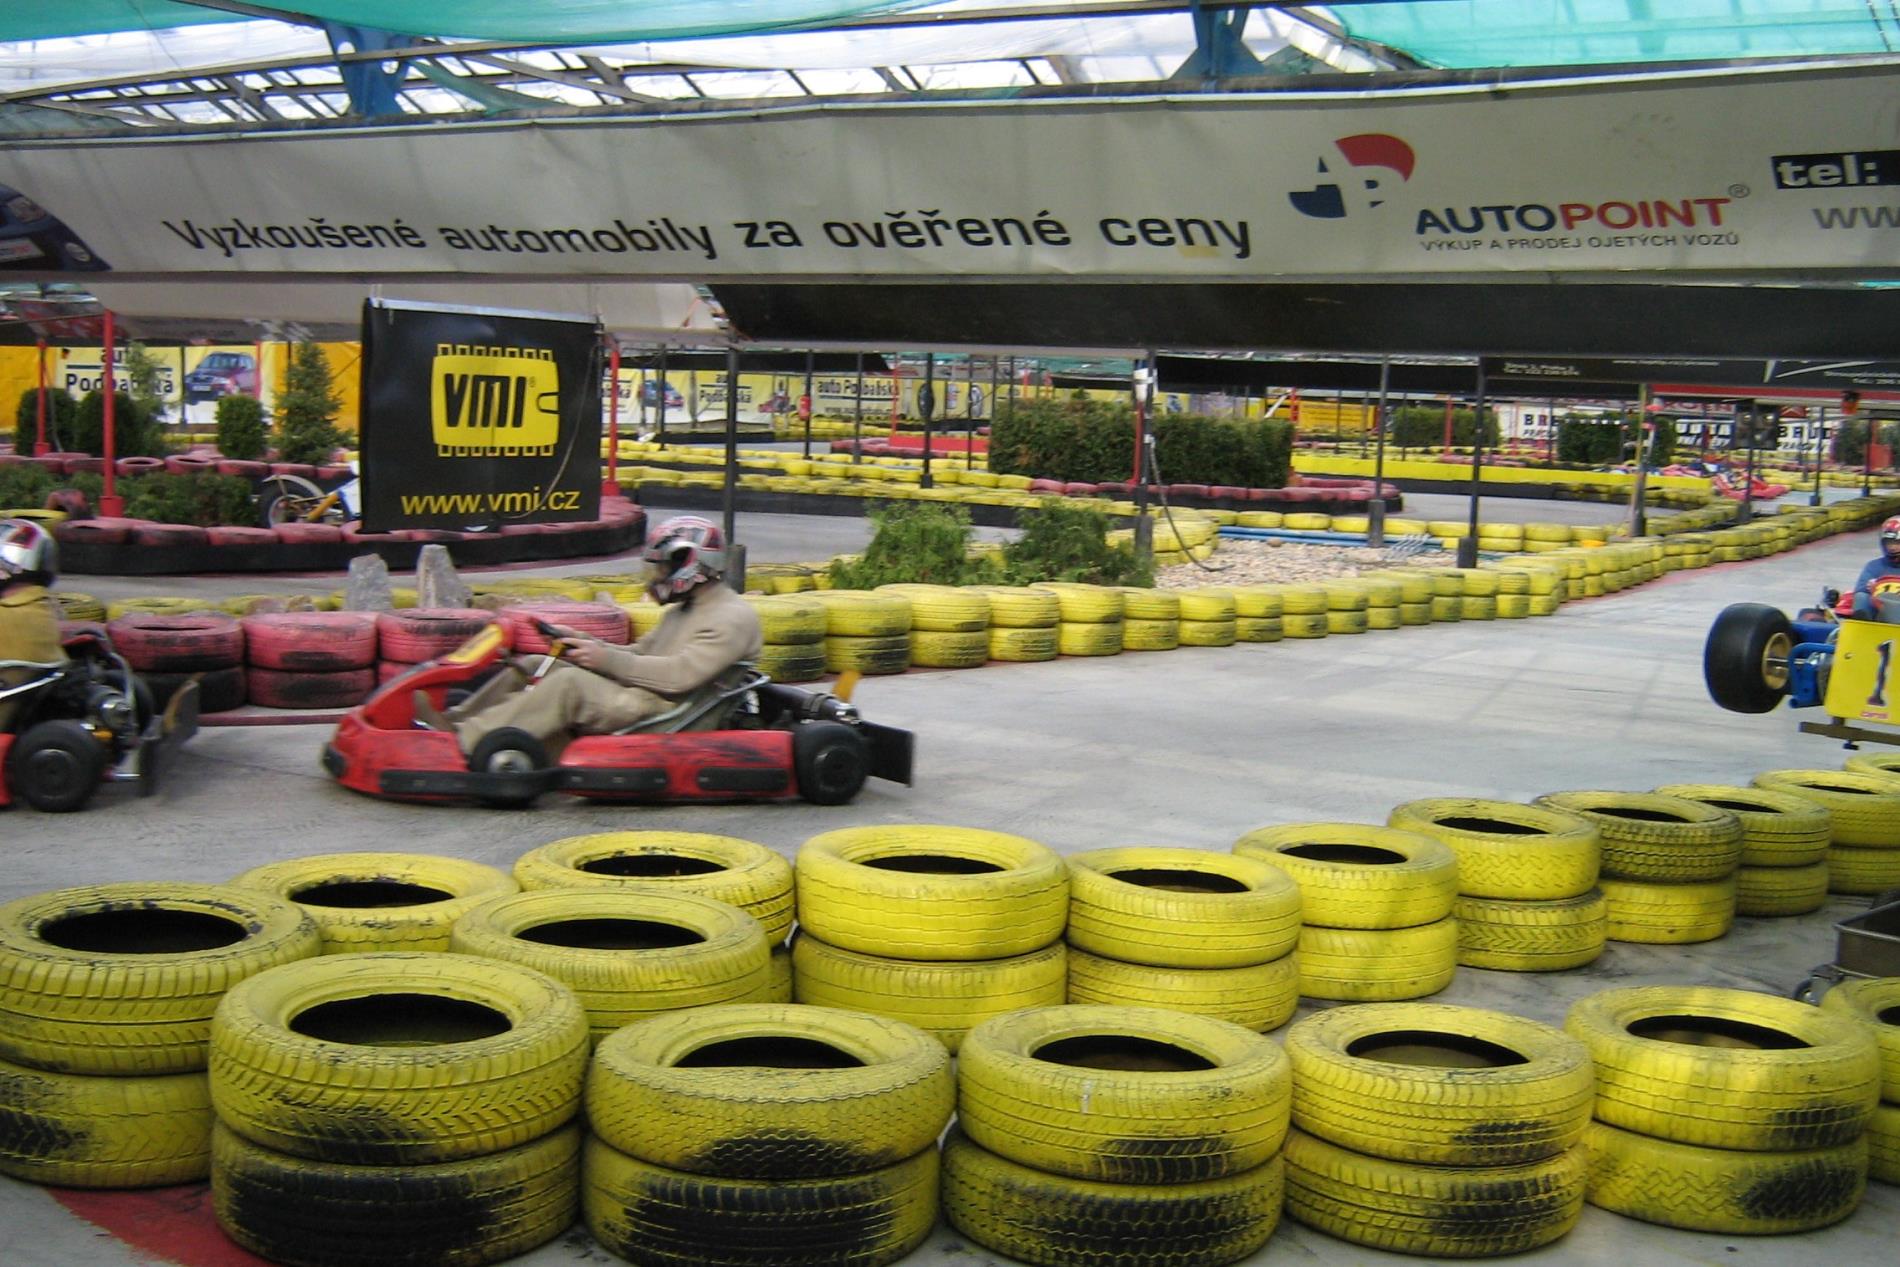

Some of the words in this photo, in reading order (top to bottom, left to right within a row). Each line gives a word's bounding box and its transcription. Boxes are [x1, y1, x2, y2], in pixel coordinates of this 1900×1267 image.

[1777, 154, 1879, 187] tel:
[1416, 198, 1731, 235] AUTOPOINT
[162, 217, 426, 258] Vyzkoušené
[438, 217, 717, 260] automobily
[733, 219, 804, 249] za
[822, 209, 1072, 249] ověřené
[1099, 216, 1251, 259] ceny
[1489, 238, 1502, 250] A
[1508, 236, 1581, 250] PRODEJ
[1587, 233, 1677, 249] OJETÝCH
[401, 486, 581, 515] www.vmi.cz
